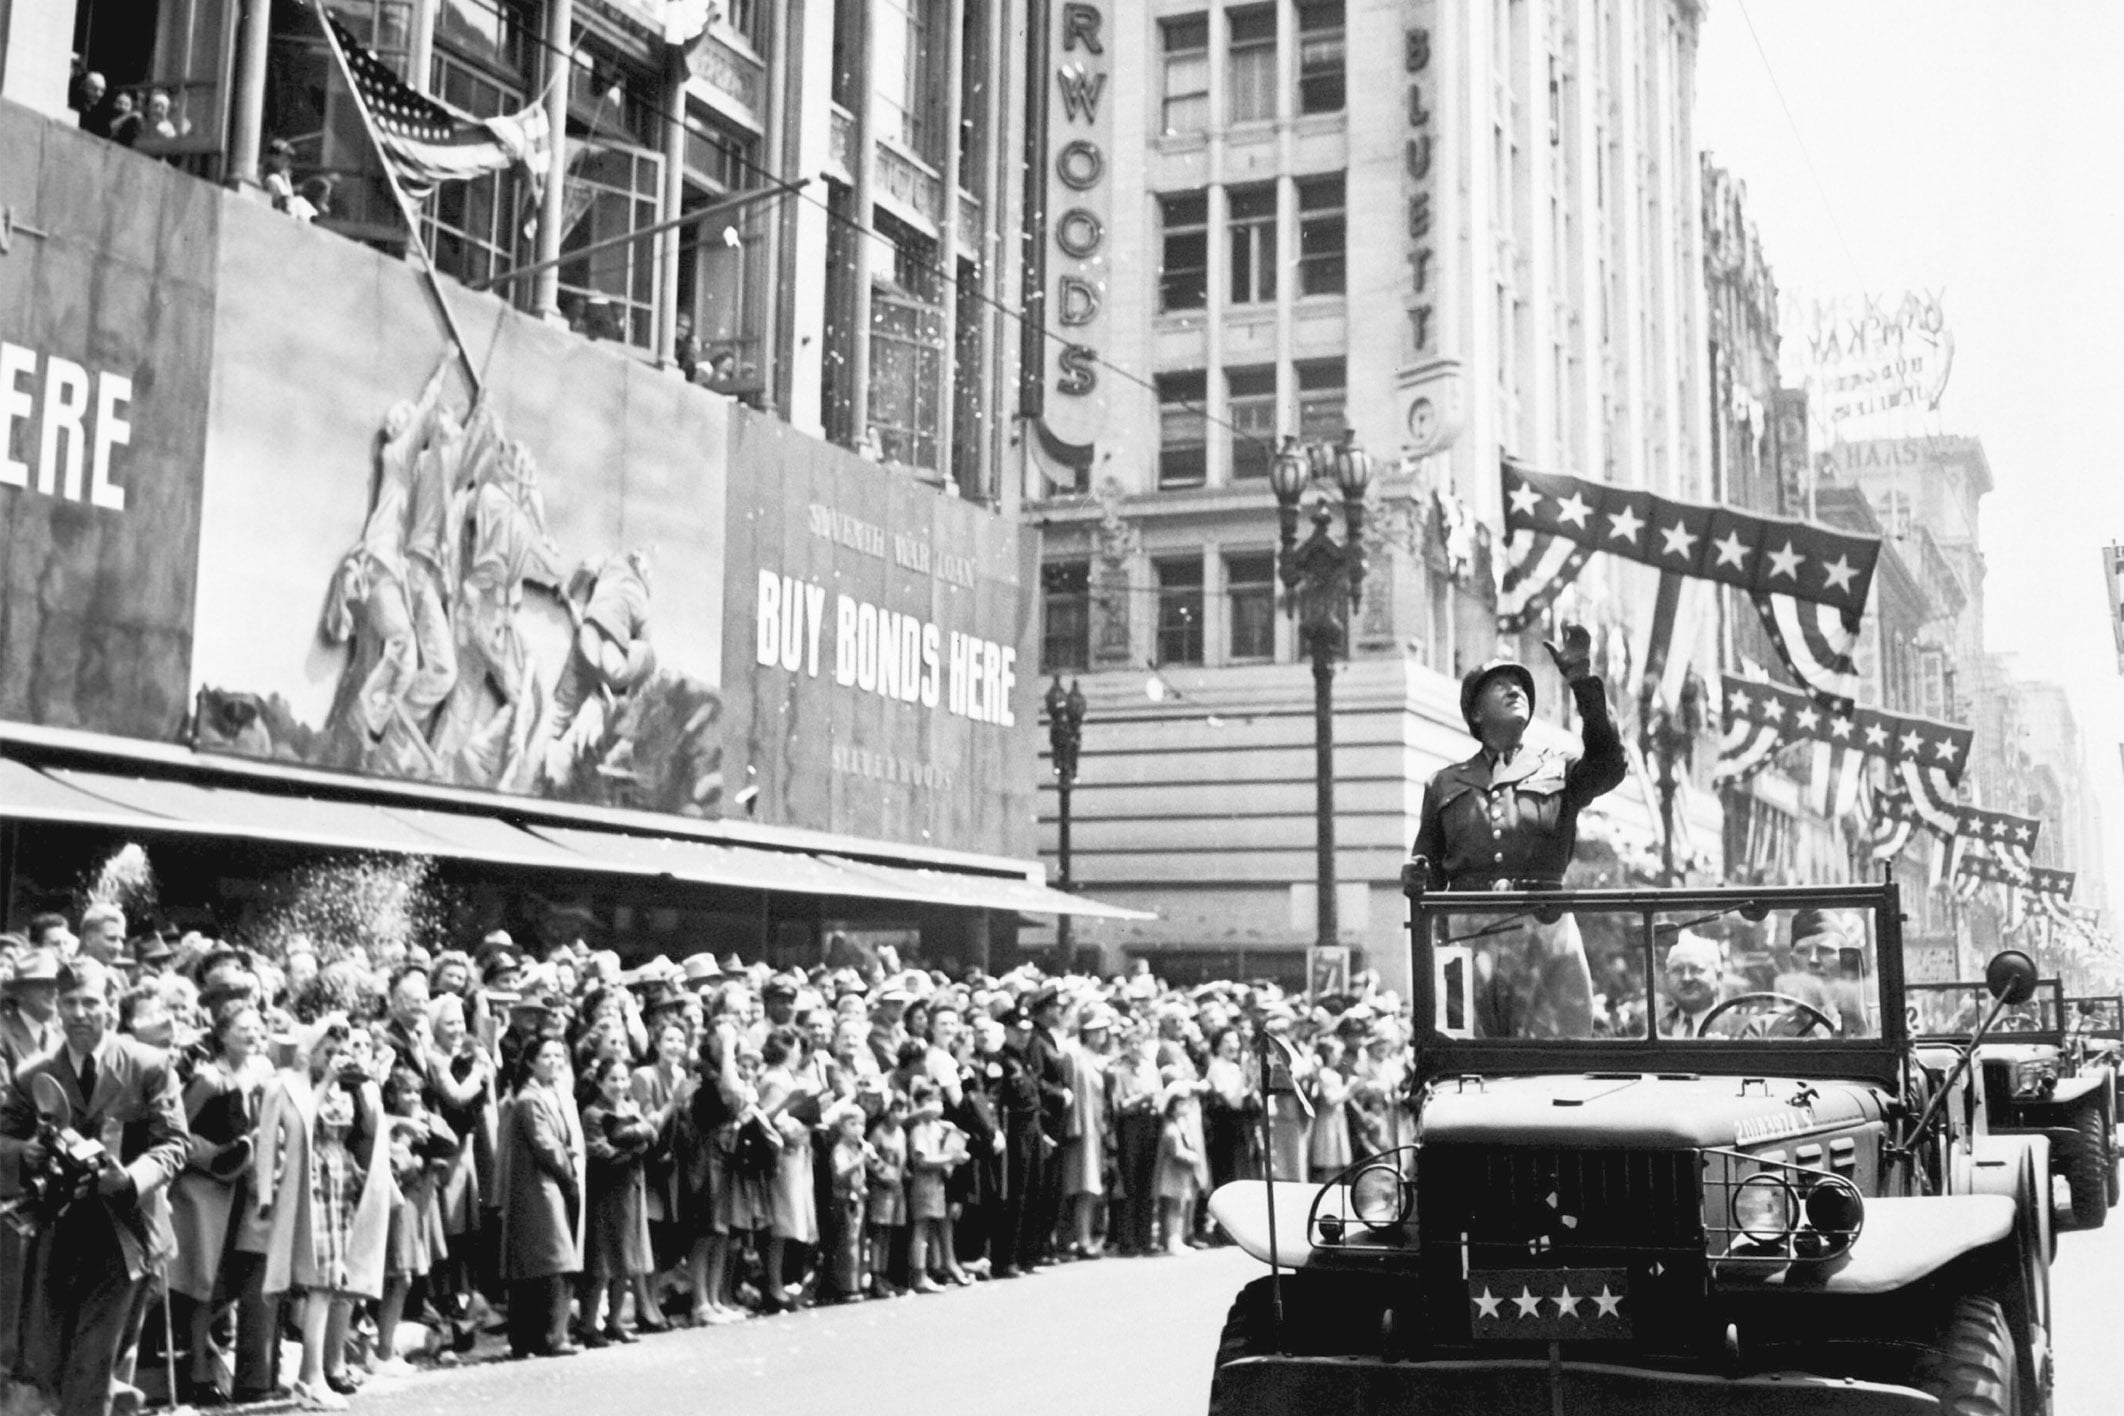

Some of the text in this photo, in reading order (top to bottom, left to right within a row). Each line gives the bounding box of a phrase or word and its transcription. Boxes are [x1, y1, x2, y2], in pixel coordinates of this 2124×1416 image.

[1057, 3, 1106, 396] RWOODS
[1405, 28, 1432, 350] BLUETT
[758, 569, 1016, 726] BUY BONDS HERE
[894, 535, 930, 573] WAR
